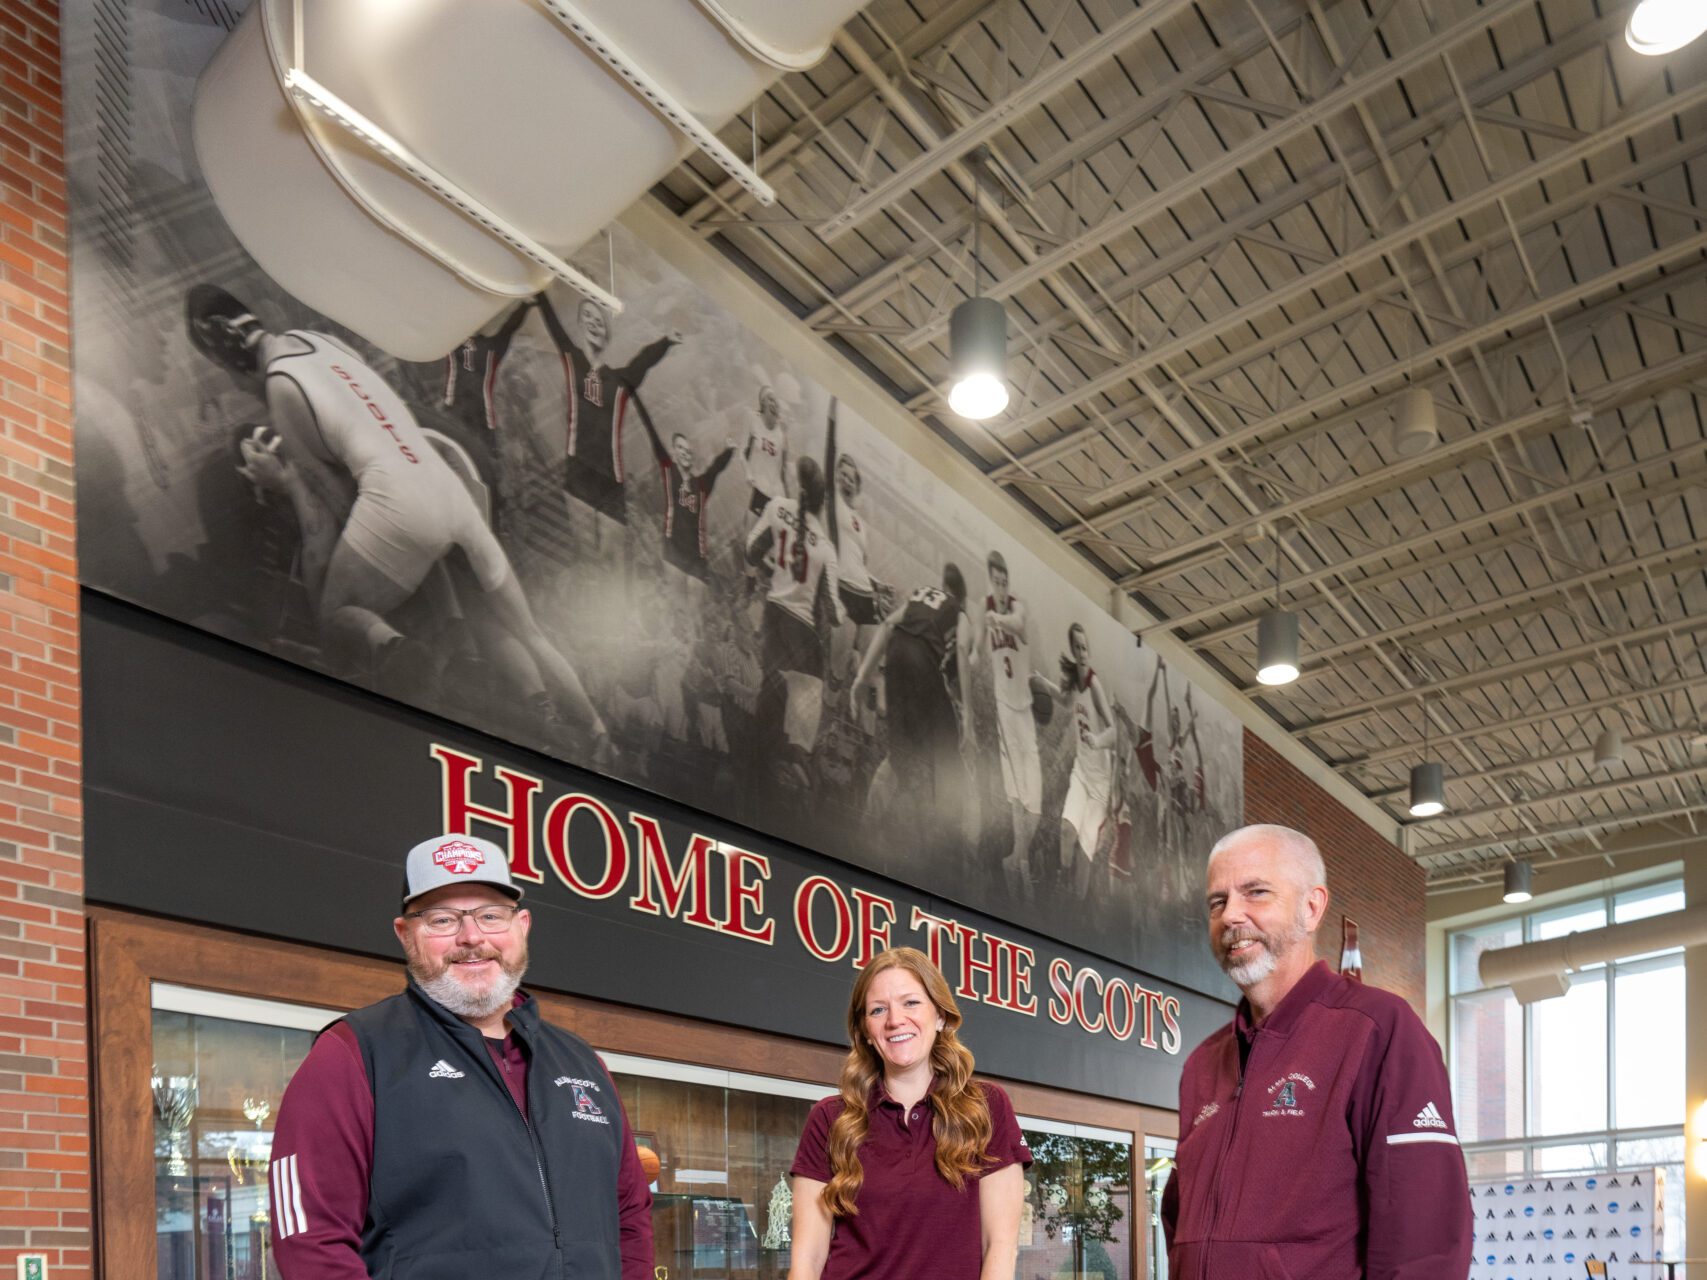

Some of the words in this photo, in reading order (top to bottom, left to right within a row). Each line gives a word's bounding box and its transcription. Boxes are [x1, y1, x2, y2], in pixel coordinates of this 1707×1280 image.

[331, 365, 419, 464] SCOTS
[434, 849, 483, 863] CHAMPIONS
[453, 860, 473, 873] A
[430, 743, 775, 945] HOME
[793, 875, 897, 970] OF
[910, 906, 1038, 1017] THE
[1048, 957, 1182, 1056] SCOTS
[429, 1070, 465, 1079] adidas
[1288, 1072, 1316, 1091] COLLEGE
[571, 1111, 610, 1125] FOOTBALL
[1412, 1118, 1448, 1129] adidas
